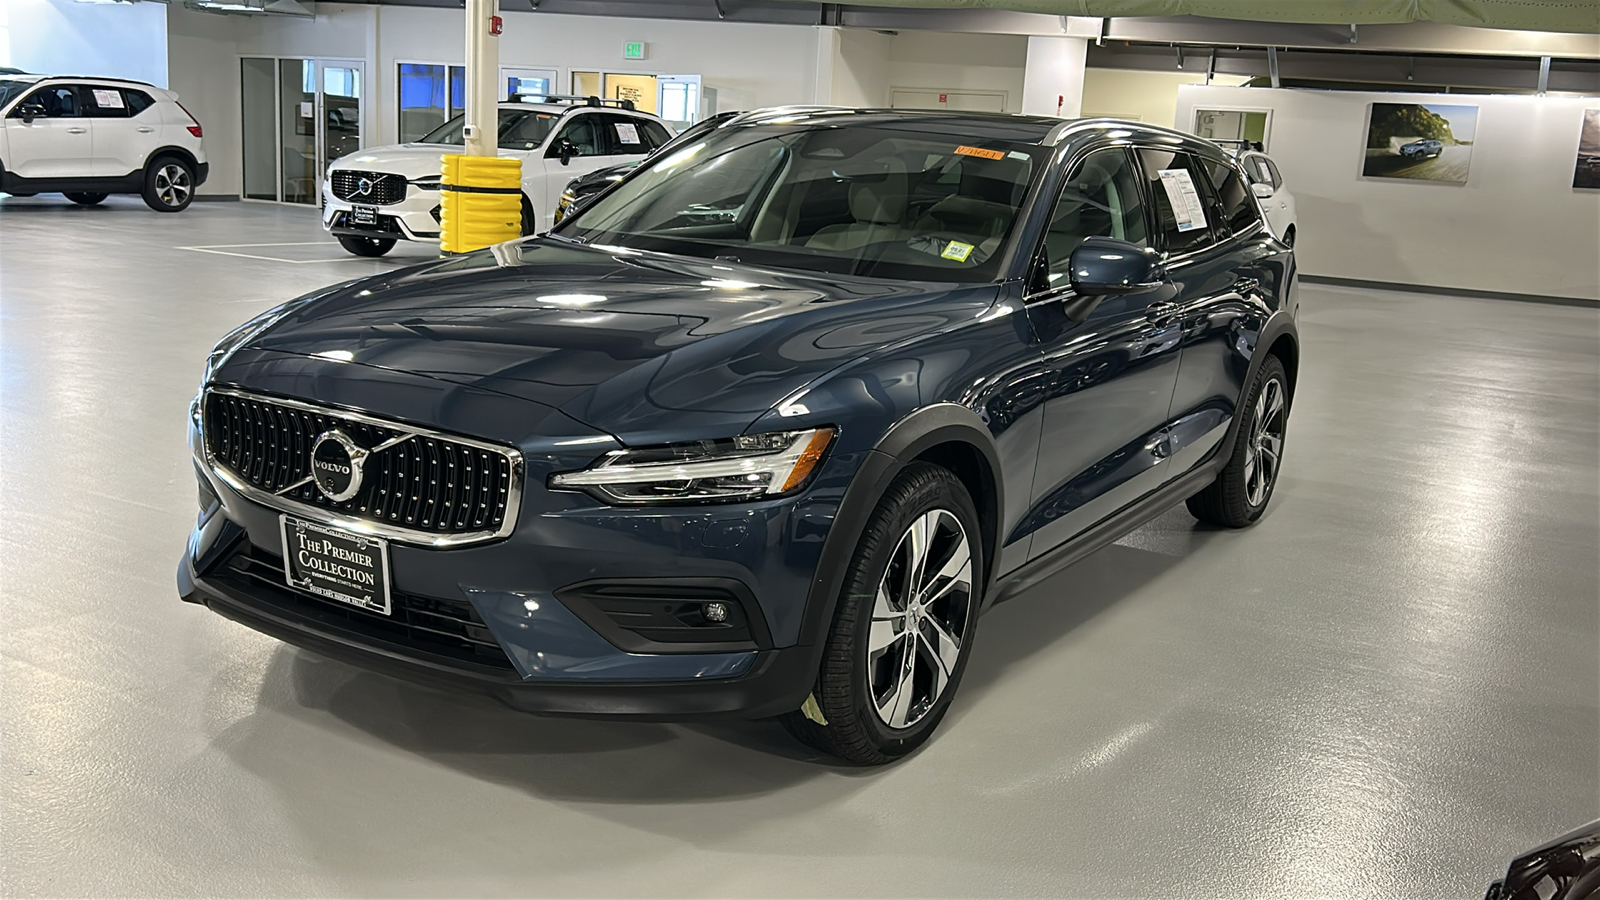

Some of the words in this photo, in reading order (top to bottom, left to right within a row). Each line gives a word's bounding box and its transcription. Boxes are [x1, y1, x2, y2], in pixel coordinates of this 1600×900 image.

[626, 42, 641, 57] EXIT
[314, 459, 351, 475] VOLVO
[296, 532, 322, 554] THE
[322, 539, 374, 568] PREMIER
[298, 550, 375, 586] COLLECTION
